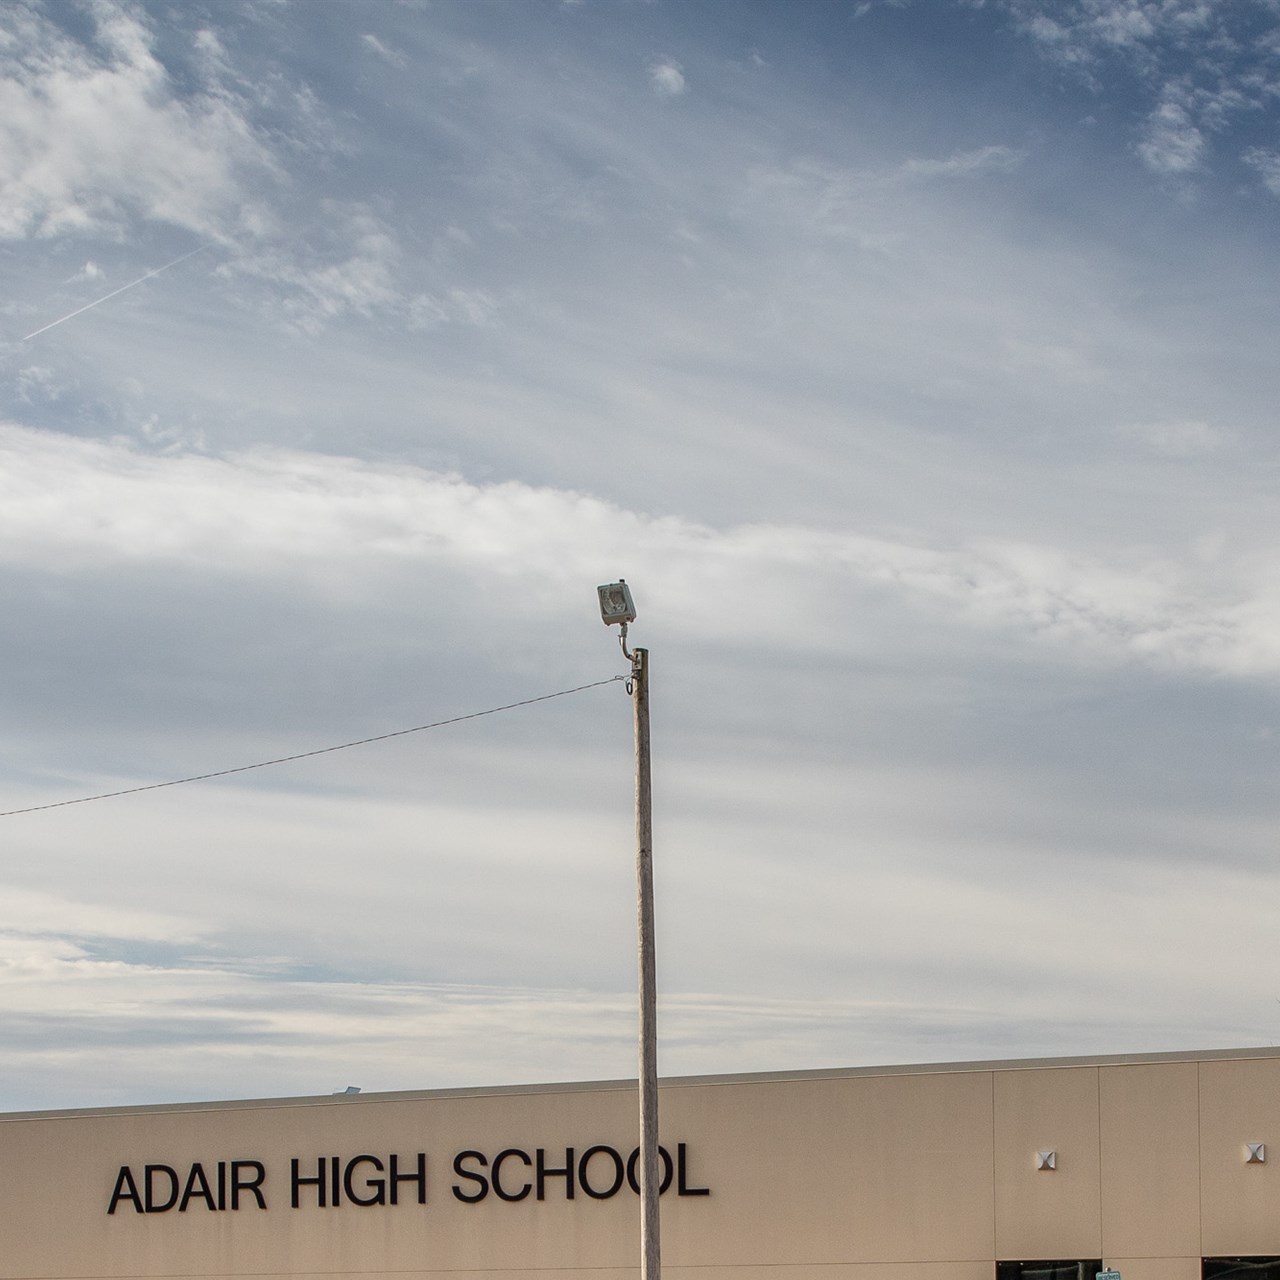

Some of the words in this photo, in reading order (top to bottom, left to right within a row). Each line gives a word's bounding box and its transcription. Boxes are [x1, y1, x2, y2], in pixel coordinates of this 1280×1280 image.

[106, 1160, 267, 1215] ADAIR
[290, 1152, 426, 1208] HIGH
[451, 1142, 710, 1203] SCHOOL
